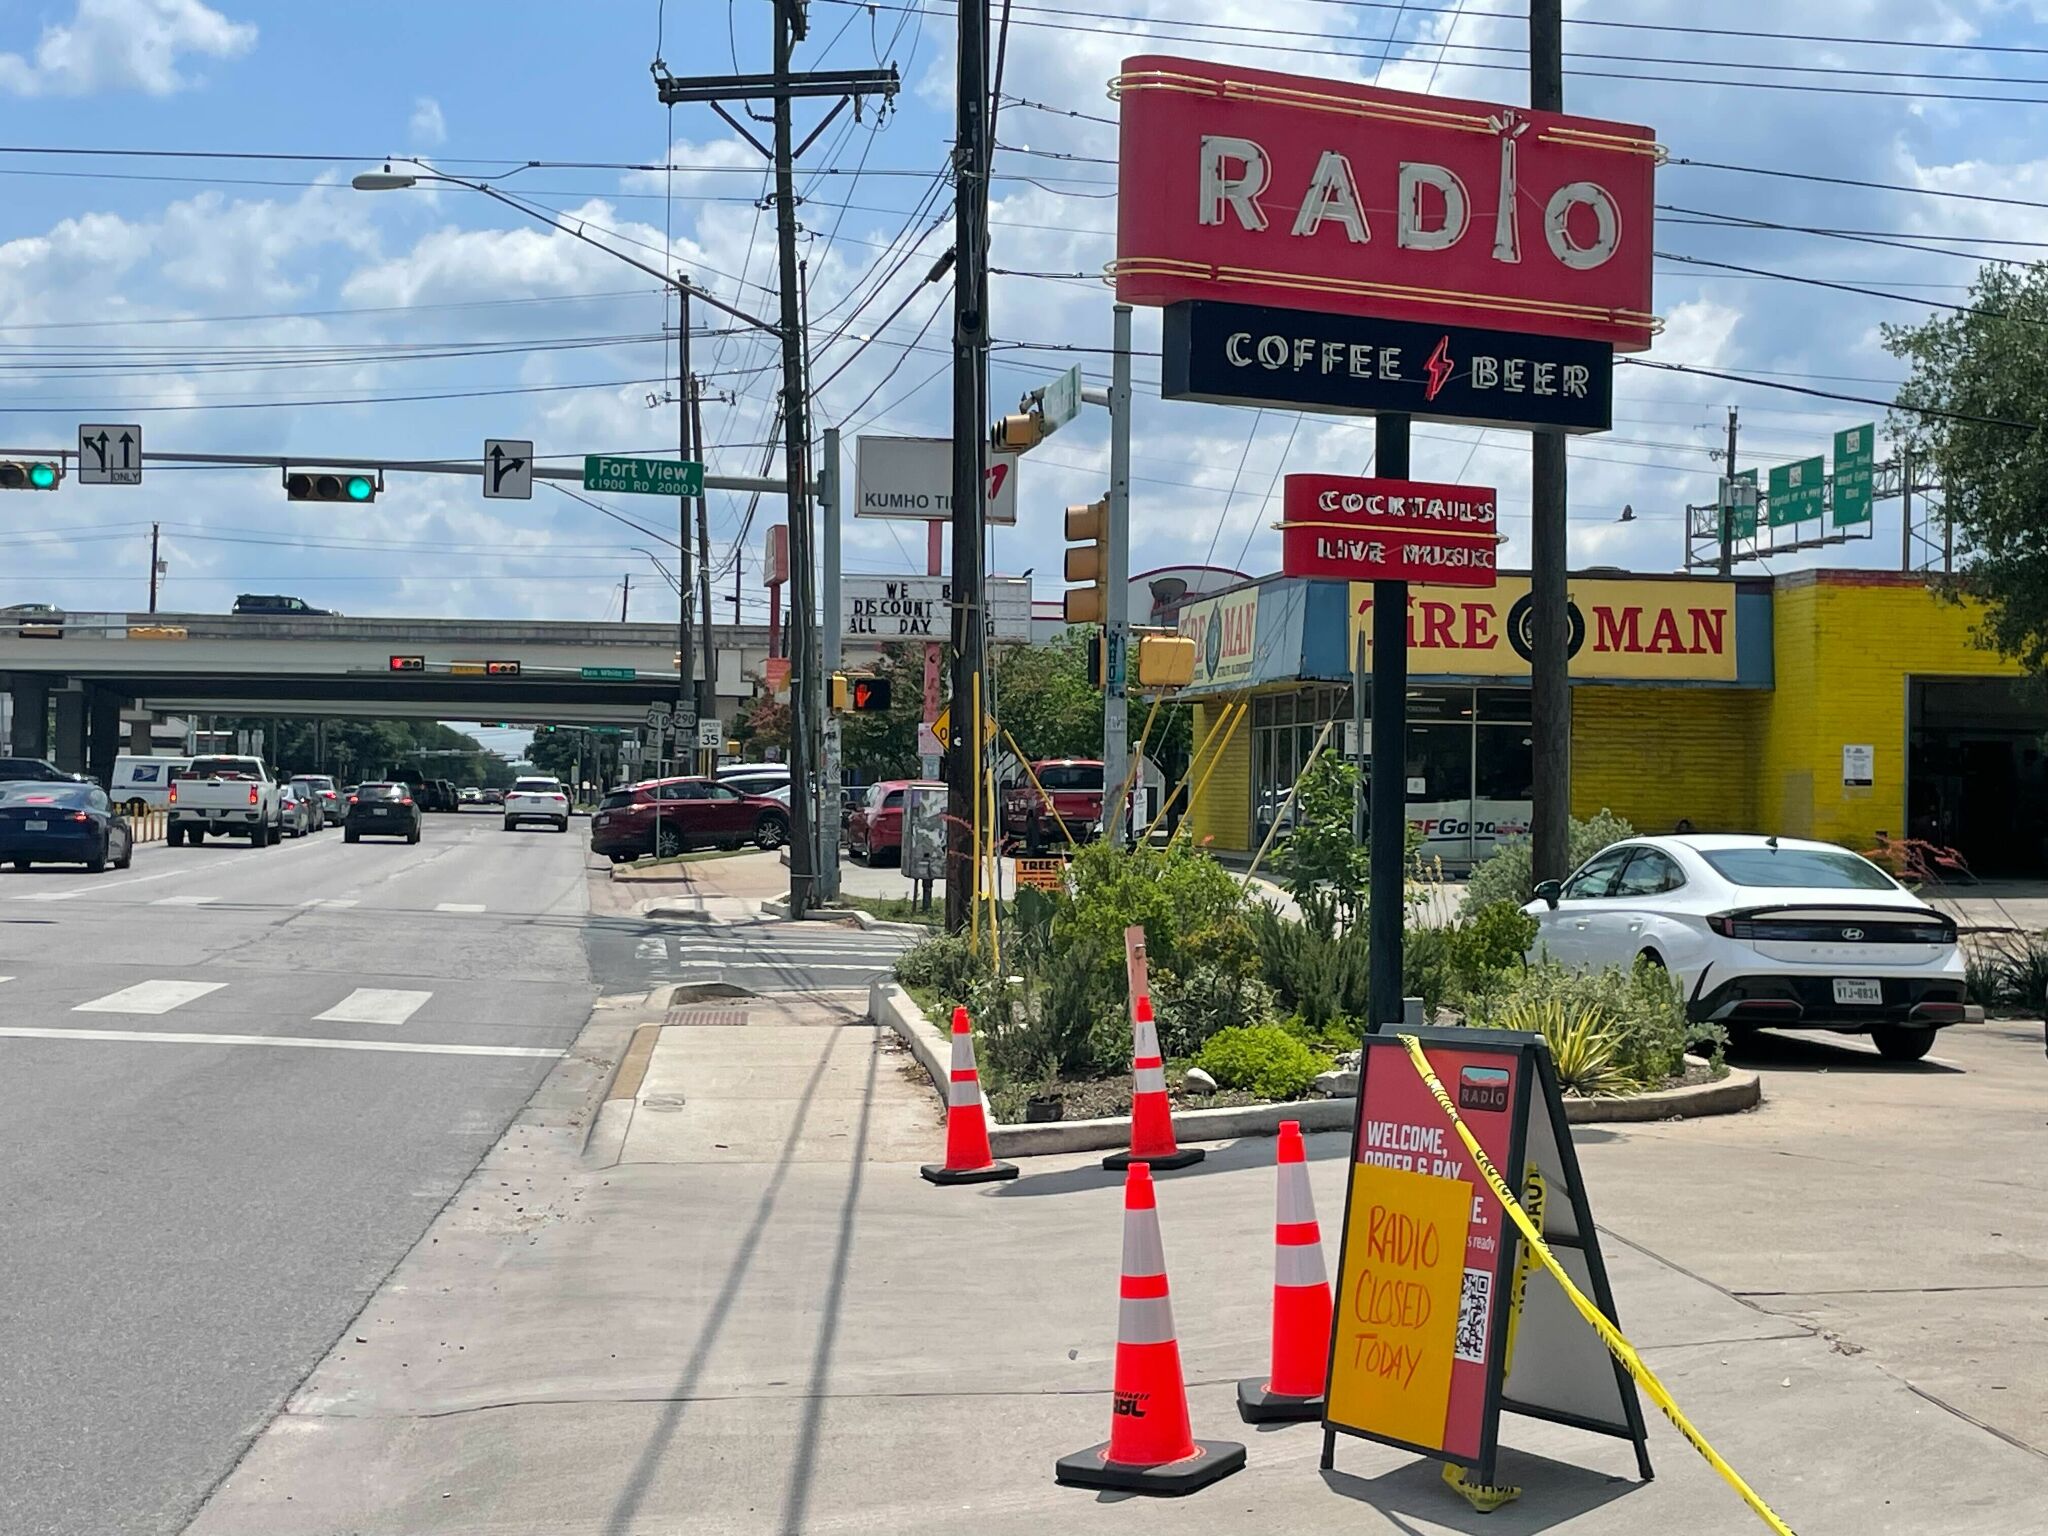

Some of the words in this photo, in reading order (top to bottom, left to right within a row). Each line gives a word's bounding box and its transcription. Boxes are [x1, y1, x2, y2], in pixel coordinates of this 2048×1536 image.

[1199, 135, 1622, 270] RADIO
[1226, 332, 1402, 380] COFFEE
[1471, 356, 1590, 398] BEER
[113, 472, 138, 482] ONLY
[599, 459, 638, 478] Fort
[645, 462, 688, 481] View
[599, 479, 626, 490] 1900
[633, 481, 650, 491] RD
[657, 483, 688, 494] 2000
[865, 493, 929, 509] KUMHO
[1318, 490, 1494, 522] COCKTAILS
[1317, 537, 1386, 564] LIVE
[1402, 544, 1494, 569] MUSIC
[886, 583, 908, 599] WE
[854, 599, 934, 617] DISCOUNT
[849, 617, 876, 633] ALL
[899, 618, 932, 635] DAY
[1222, 602, 1256, 658] MAN
[1593, 606, 1728, 655] MAN
[649, 713, 668, 726] 20
[675, 713, 695, 725] 290
[702, 734, 719, 746] 35
[1021, 860, 1059, 871] TREES
[1461, 1088, 1505, 1106] RADIO
[1368, 1120, 1448, 1158] WELCOME,
[1367, 1205, 1439, 1270] RADIO
[1473, 1236, 1495, 1251] ready
[1355, 1269, 1431, 1330] CLOSED
[1355, 1333, 1423, 1391] TODAY
